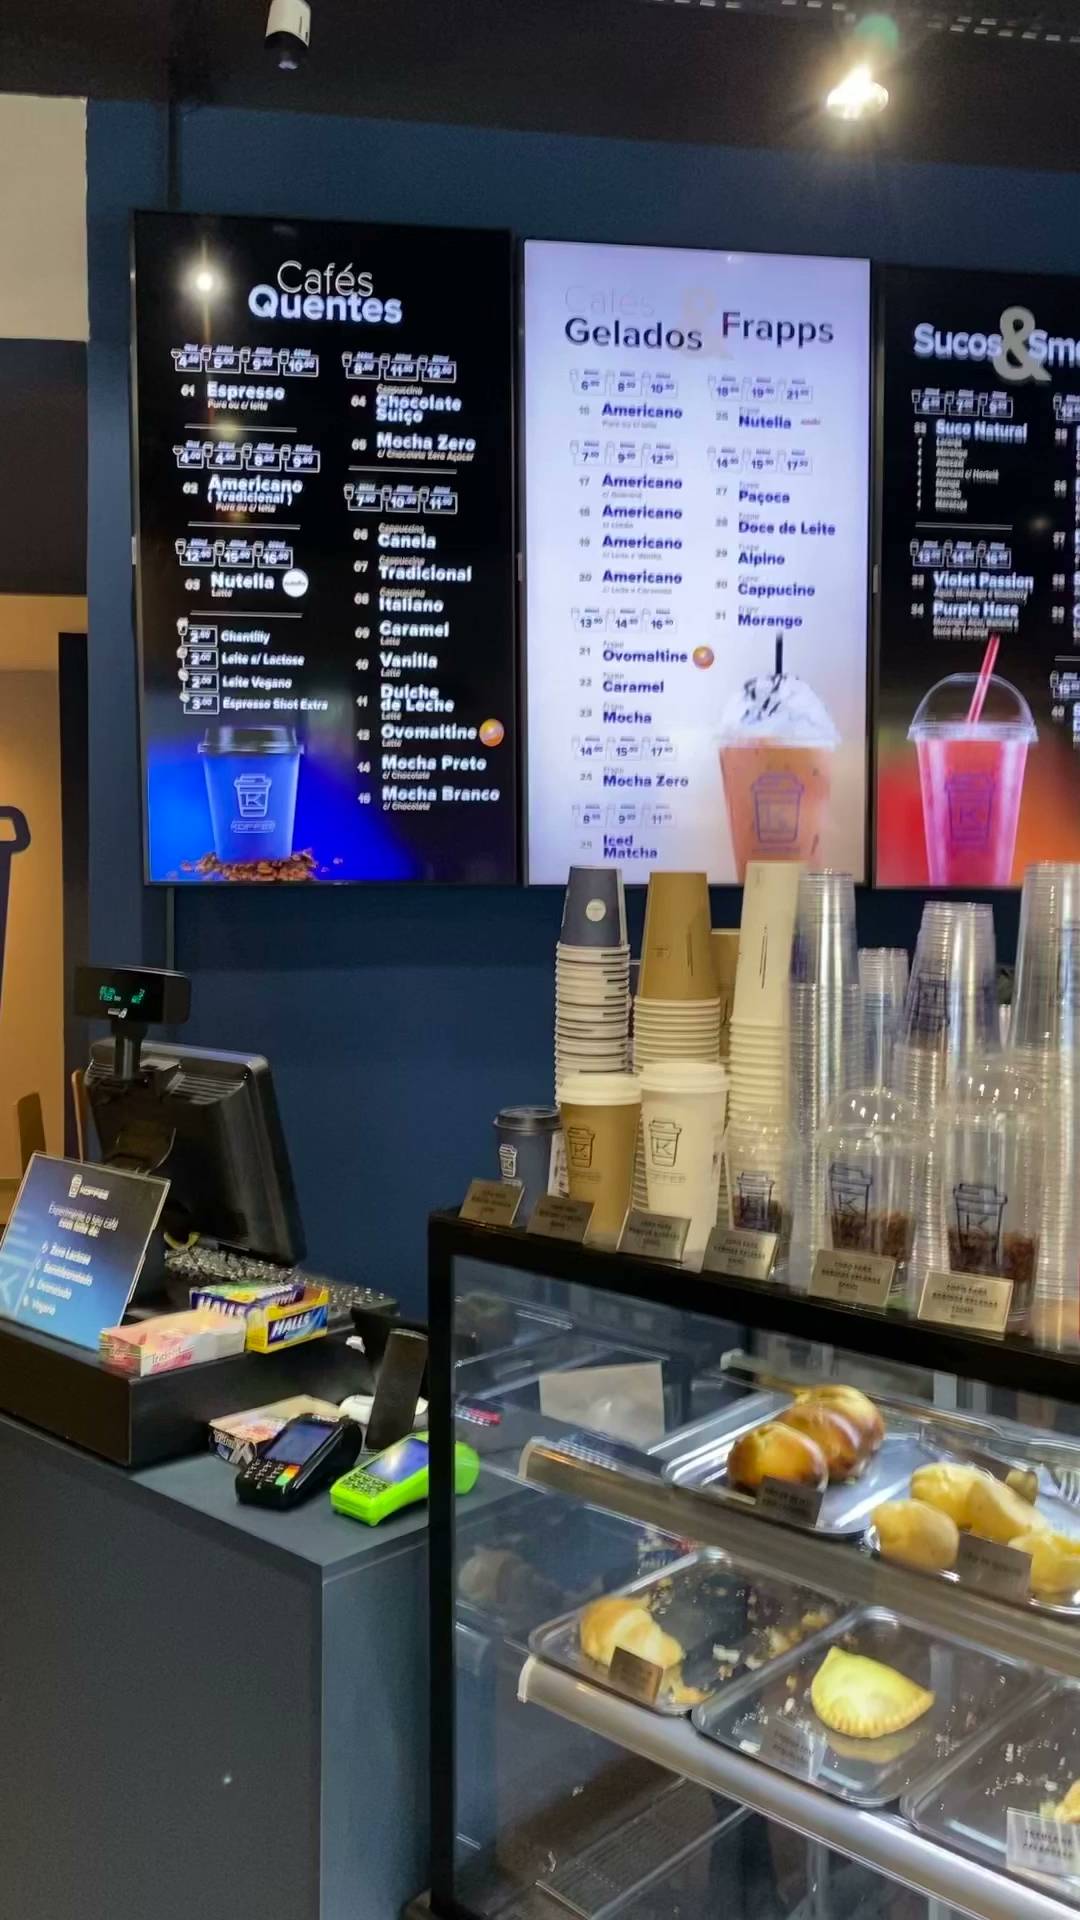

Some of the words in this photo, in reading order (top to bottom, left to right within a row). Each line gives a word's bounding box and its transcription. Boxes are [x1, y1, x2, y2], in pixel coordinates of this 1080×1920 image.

[277, 259, 374, 297] Cafés
[248, 283, 403, 324] Quentes
[564, 317, 703, 350] Gelados
[722, 311, 834, 349] Frapps
[914, 322, 1002, 360] Sucos
[994, 305, 1052, 384] &
[1028, 329, 1080, 367] Sm
[207, 381, 286, 401] Espresso
[376, 394, 462, 411] Chocolate
[602, 401, 683, 418] Americano
[376, 408, 424, 426] Suiço
[738, 415, 791, 429] Nutella
[936, 419, 971, 437] Suco
[974, 420, 1028, 443] Natural
[376, 432, 433, 450] Mocha
[437, 434, 477, 452] Zero
[208, 474, 303, 493] Americano
[602, 472, 683, 489] Americano
[738, 489, 791, 506] Paçoca
[602, 504, 683, 519] Americano
[738, 520, 775, 534] Doce
[779, 521, 796, 535] de
[801, 521, 836, 535] Leite
[378, 533, 437, 549] Canela
[602, 534, 683, 549] Americano
[738, 551, 785, 567] Alpino
[211, 571, 275, 590] Nutella
[378, 564, 473, 582] Tradicional
[602, 569, 683, 584] Americano
[738, 582, 816, 598] Cappucino
[933, 571, 976, 589] Violet
[980, 573, 1033, 593] Passion
[379, 597, 445, 613] Italiano
[933, 601, 980, 619] Purple
[983, 602, 1019, 619] Haze
[379, 620, 450, 638] Caramel
[738, 613, 803, 629] Morango
[221, 630, 271, 645] Chantilly
[221, 652, 249, 665] Leite
[263, 654, 305, 666] Lactose
[379, 651, 439, 669] Vanilla
[602, 648, 688, 662] Ovomaltine
[222, 675, 250, 688] Leite
[251, 677, 293, 690] Vegano
[602, 680, 664, 693] Caramel
[380, 683, 439, 700] Dulche
[223, 697, 270, 710] Espresso
[273, 697, 298, 710] Shot
[300, 699, 328, 710] Extra
[380, 698, 402, 713] de
[405, 699, 455, 713] Leche
[603, 711, 652, 724] Mocha
[381, 722, 477, 740] Ovomaltine
[381, 754, 437, 770] Mocha
[441, 755, 488, 771] Preto
[603, 774, 652, 787] Mocha
[656, 775, 689, 788] Zero
[382, 785, 437, 801] Mocha
[441, 786, 500, 801] Branco
[603, 834, 633, 847] Iced
[603, 846, 658, 859] Matcha
[270, 1313, 310, 1341] HALLS
